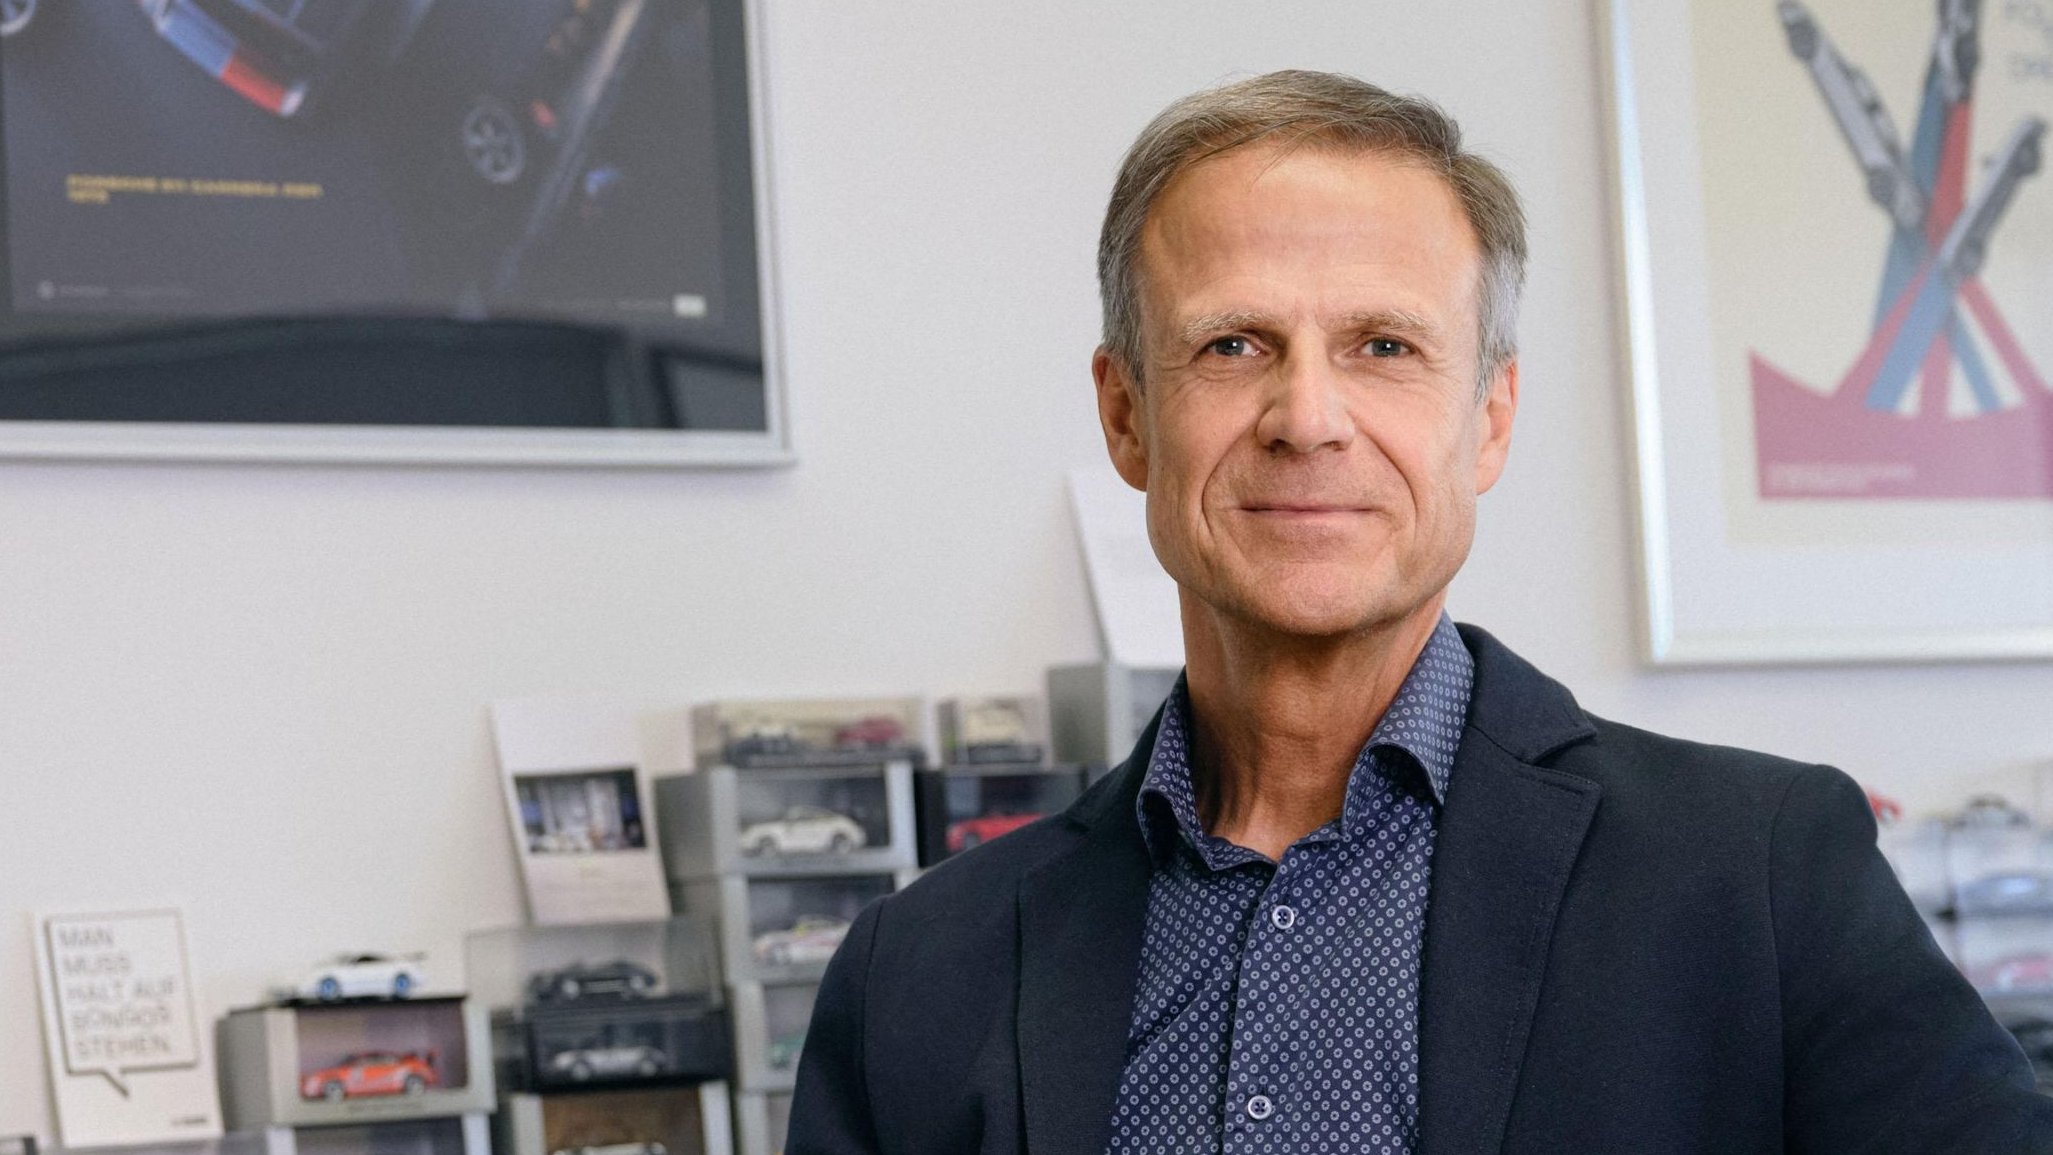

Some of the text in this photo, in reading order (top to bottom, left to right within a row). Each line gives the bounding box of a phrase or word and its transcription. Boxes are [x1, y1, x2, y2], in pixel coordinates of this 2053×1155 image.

[59, 927, 114, 947] MAN
[63, 952, 131, 976] MUSS
[67, 976, 174, 1002] HALT AUF
